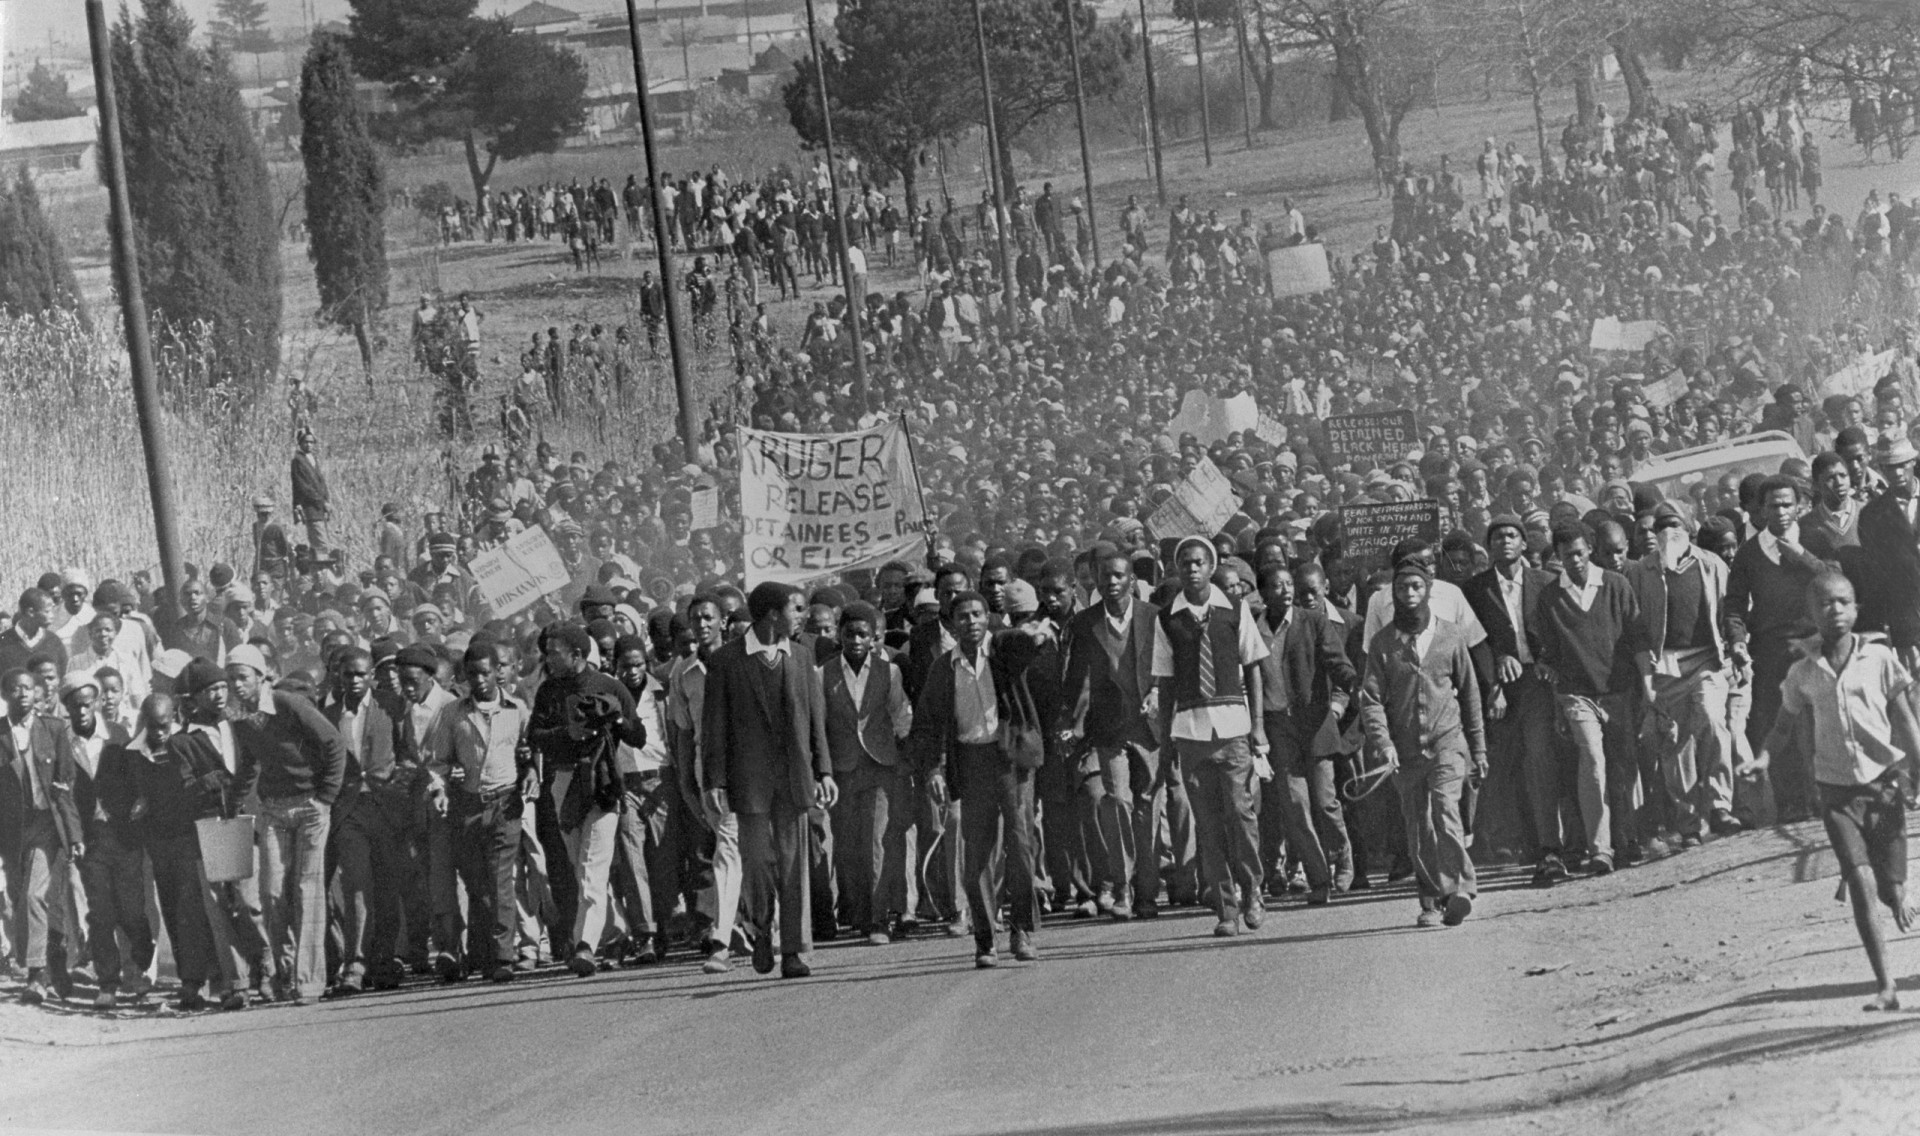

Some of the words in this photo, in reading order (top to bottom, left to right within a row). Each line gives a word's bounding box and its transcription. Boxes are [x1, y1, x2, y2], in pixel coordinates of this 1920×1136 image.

[1329, 428, 1405, 441] DETAINED
[1331, 441, 1374, 453] BLACK
[766, 481, 892, 516] RELEASE
[1343, 507, 1368, 518] FEAR
[1356, 516, 1374, 525] NOR
[1376, 513, 1408, 524] DEATH
[1409, 512, 1432, 522] AND
[743, 516, 871, 546] DETAINEES
[1347, 526, 1374, 537] UNITE
[1379, 525, 1392, 535] IN
[1395, 523, 1419, 535] THE
[751, 546, 790, 570] OR
